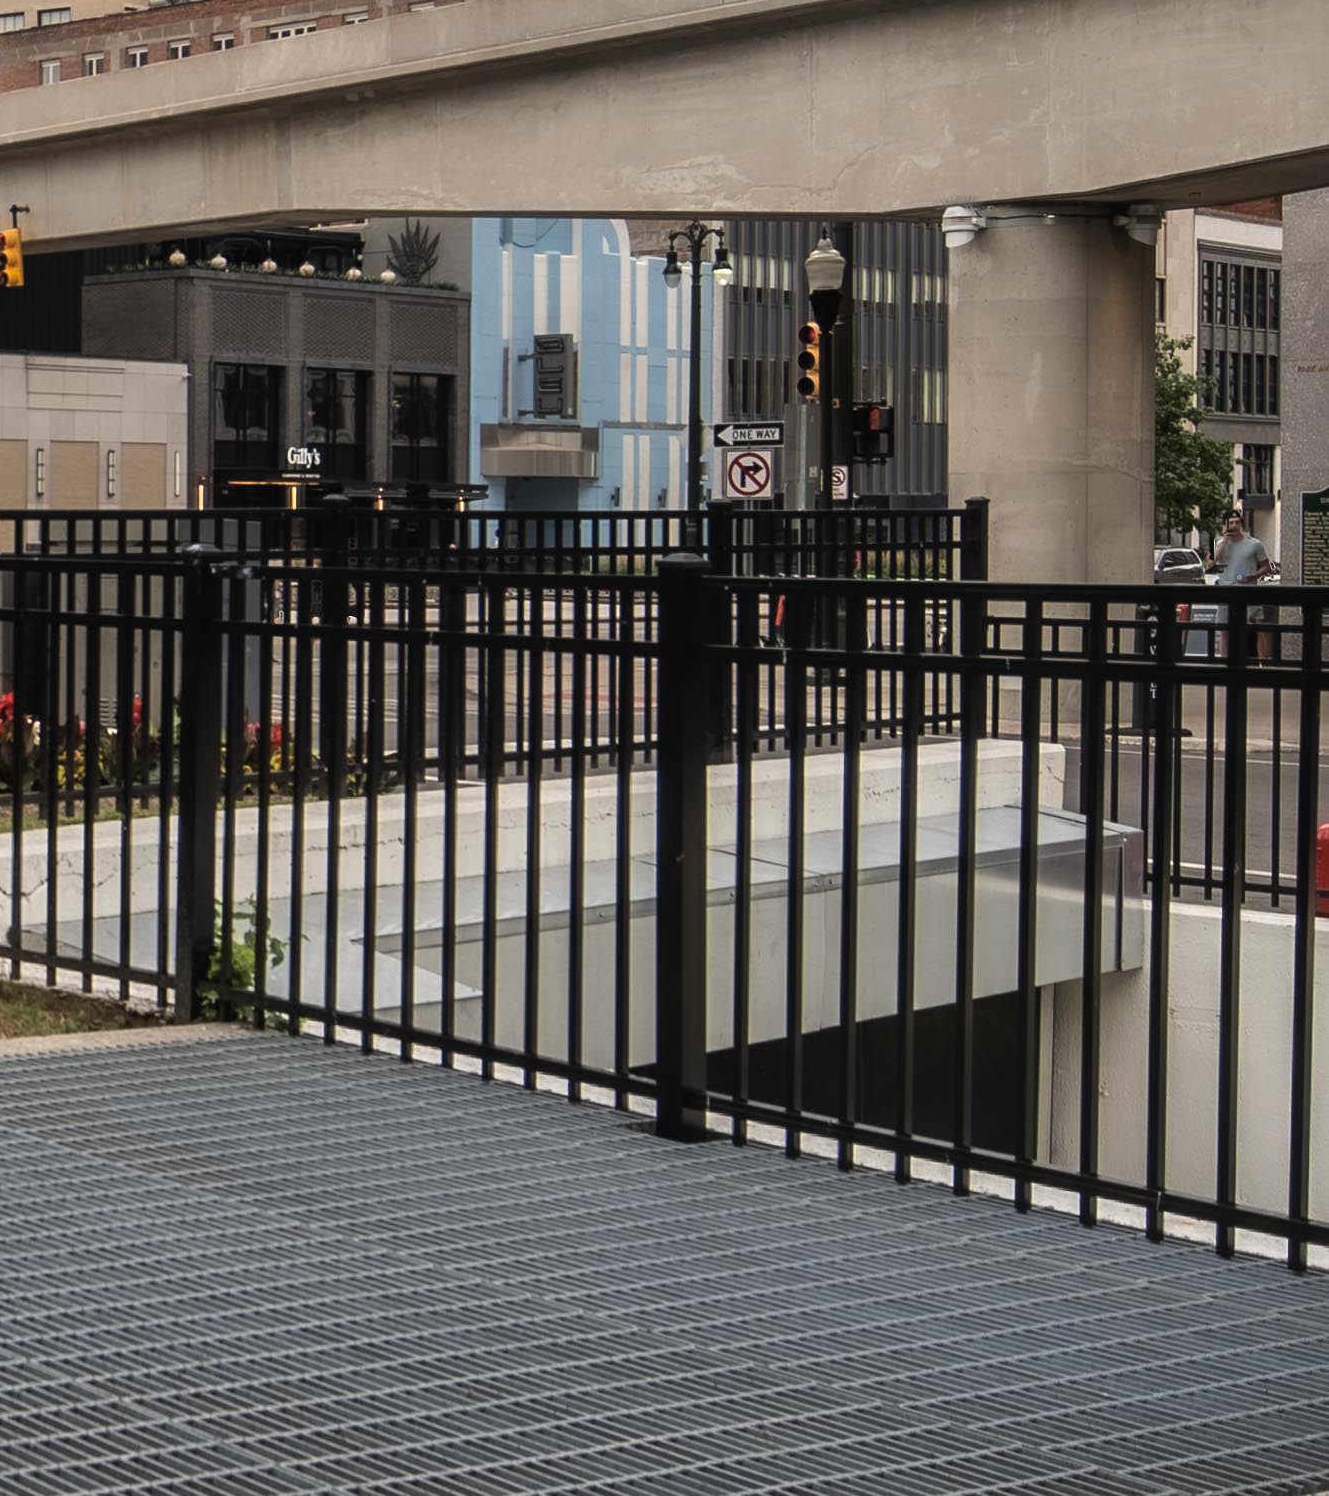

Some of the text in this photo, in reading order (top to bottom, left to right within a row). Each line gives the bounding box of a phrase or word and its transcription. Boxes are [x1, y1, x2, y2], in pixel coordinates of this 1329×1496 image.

[732, 429, 777, 440] ONE WAY
[287, 446, 320, 469] Gilly's
